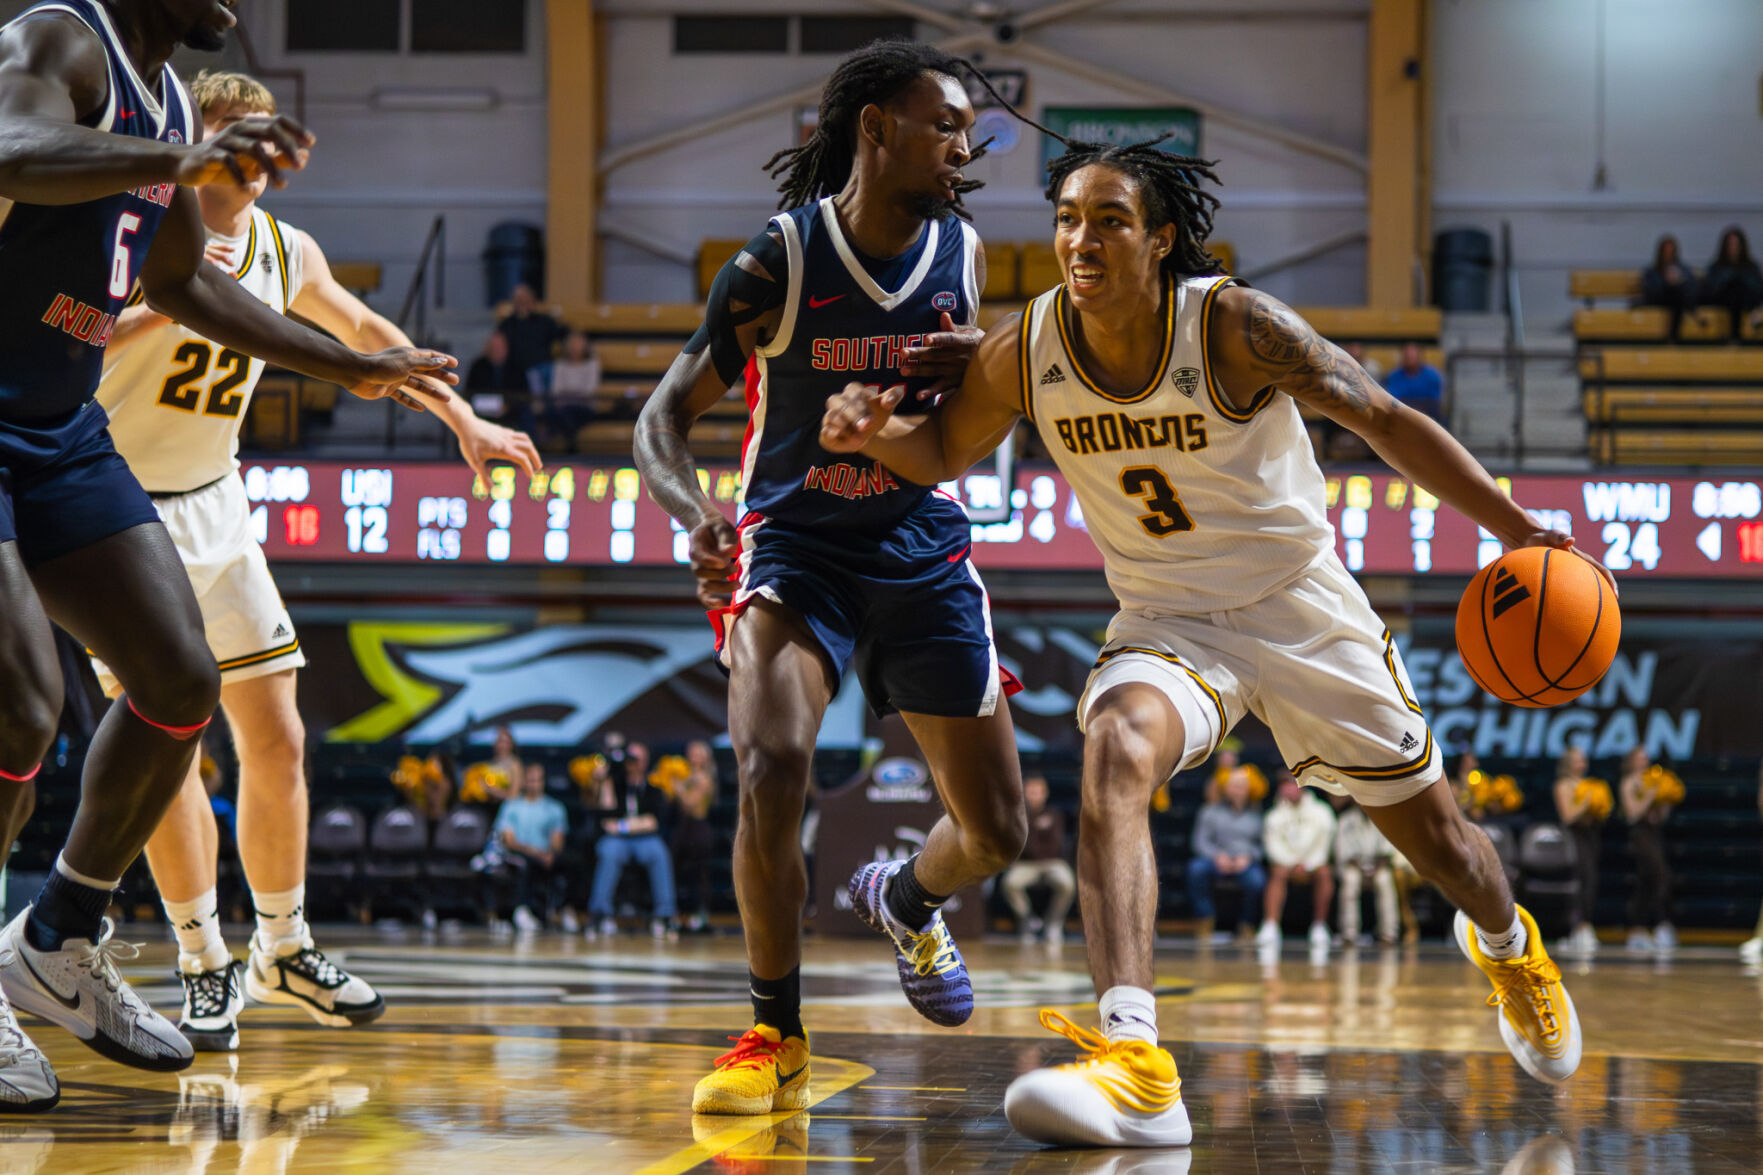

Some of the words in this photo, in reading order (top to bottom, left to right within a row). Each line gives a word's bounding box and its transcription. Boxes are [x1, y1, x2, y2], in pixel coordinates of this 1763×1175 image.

[107, 210, 142, 299] 6
[41, 293, 115, 347] INDIA
[811, 333, 930, 371] SOUTHE
[155, 338, 253, 420] 22
[1054, 412, 1209, 455] BRONCOS
[803, 460, 900, 500] INDIANA
[1118, 464, 1197, 540] 3
[1582, 481, 1671, 523] WMU
[344, 506, 389, 553] 12
[1601, 522, 1663, 571] 24
[1424, 705, 1700, 760] CHIGAN
